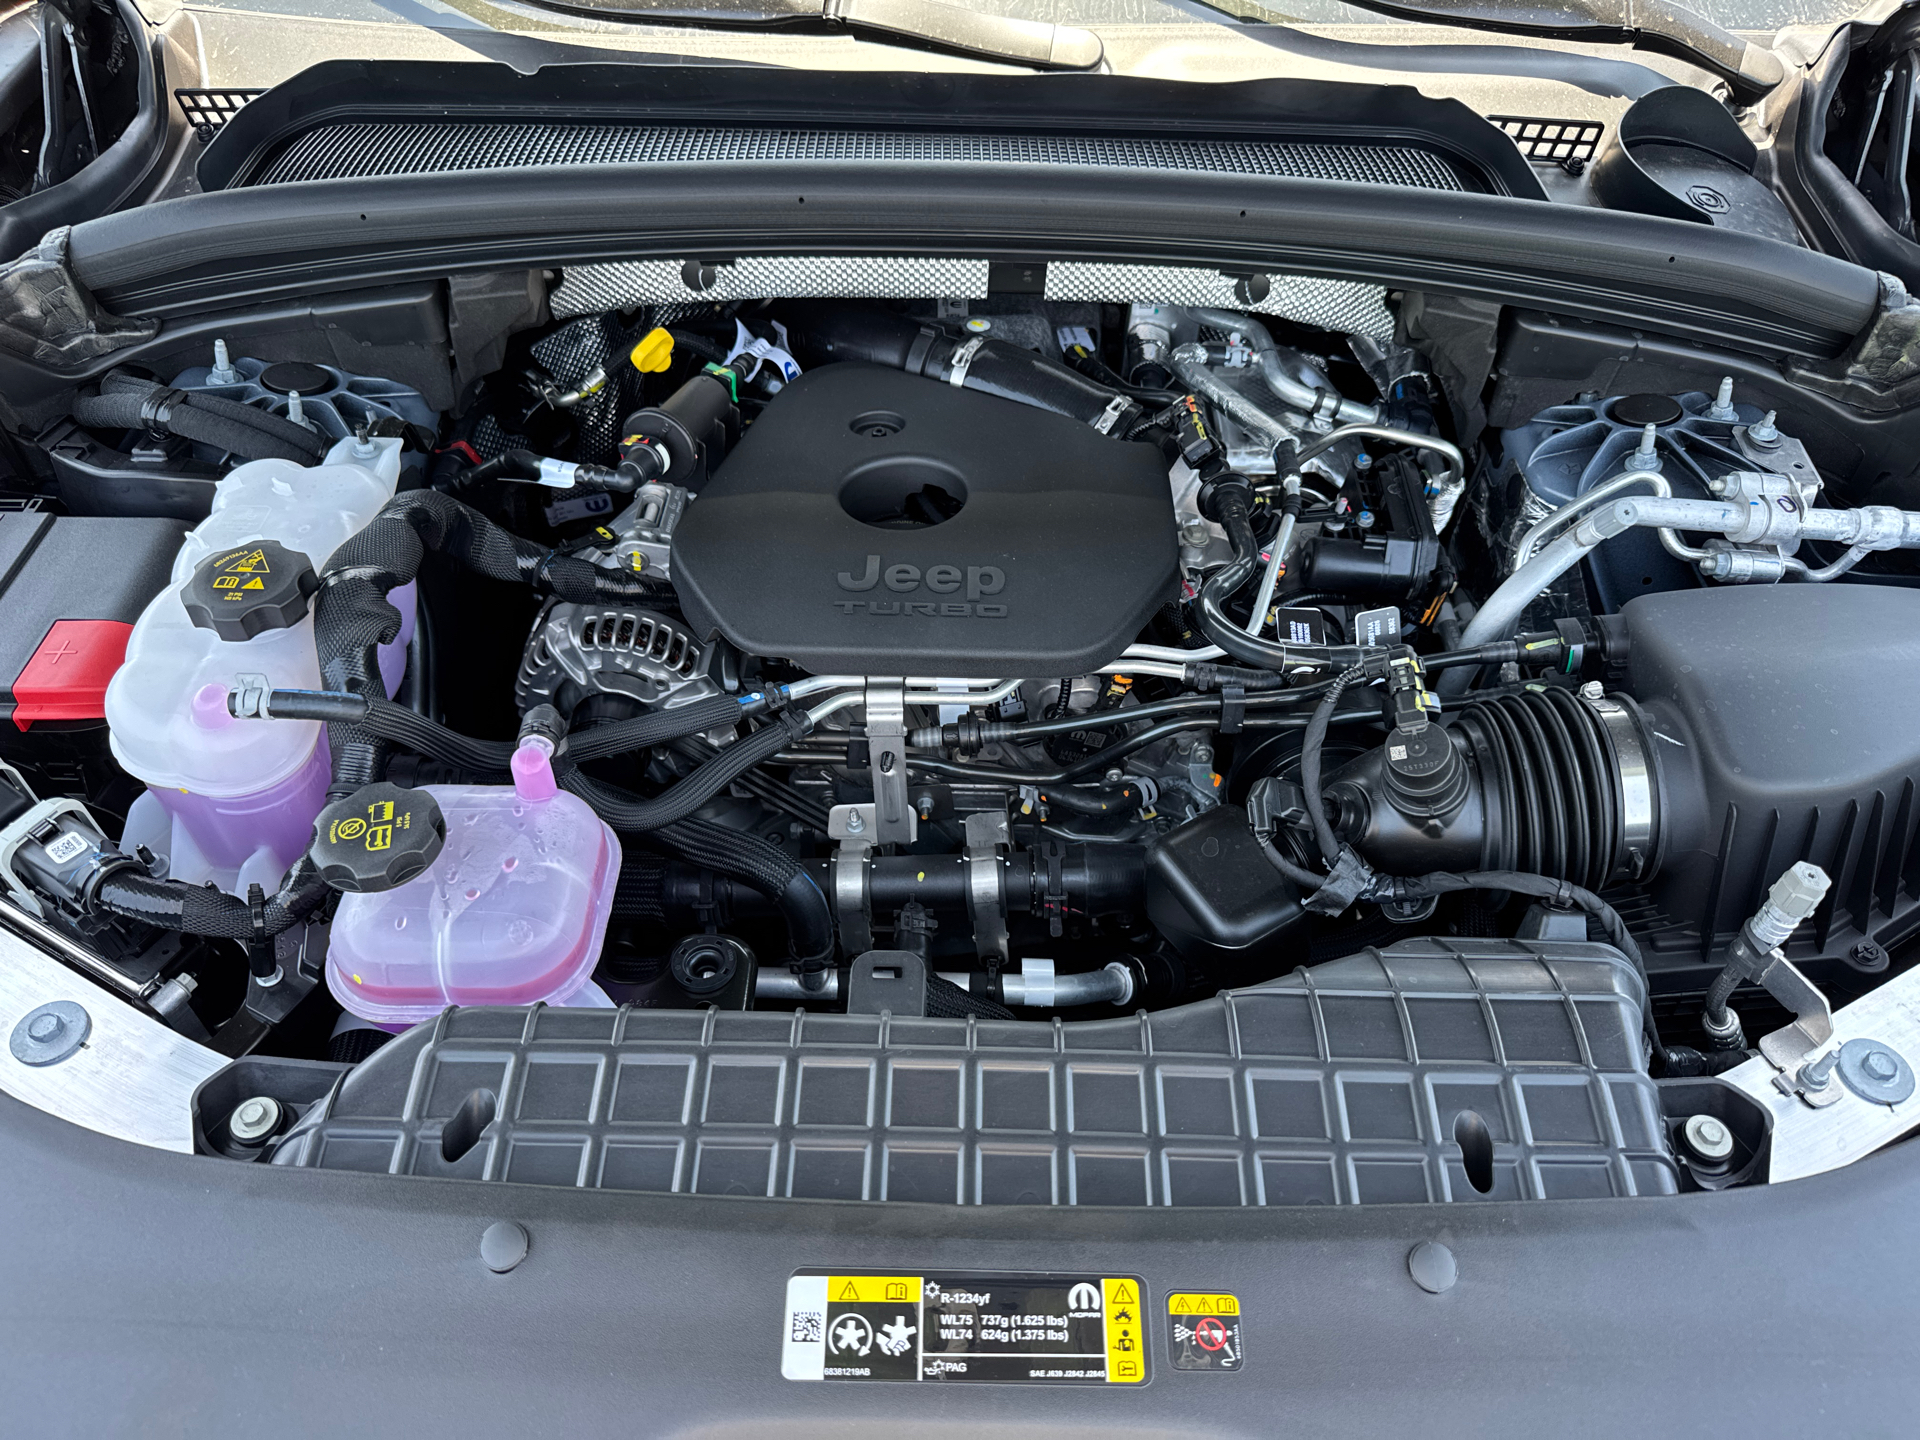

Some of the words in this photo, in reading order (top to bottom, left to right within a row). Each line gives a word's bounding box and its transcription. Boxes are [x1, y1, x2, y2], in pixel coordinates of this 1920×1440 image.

[837, 554, 1006, 602] Jeep
[833, 600, 1008, 618] TURBO
[940, 1293, 991, 1306] R-1234yf
[940, 1314, 974, 1326] WL75
[980, 1314, 1009, 1328] 737g
[1010, 1314, 1045, 1328] (1.625
[1046, 1314, 1069, 1328] lbs)
[940, 1329, 974, 1340] WL74
[980, 1329, 1009, 1342] 624g
[1010, 1329, 1045, 1343] (1.375
[1046, 1329, 1070, 1343] lbs)
[945, 1363, 968, 1373] PAG
[1029, 1369, 1046, 1378] SAE
